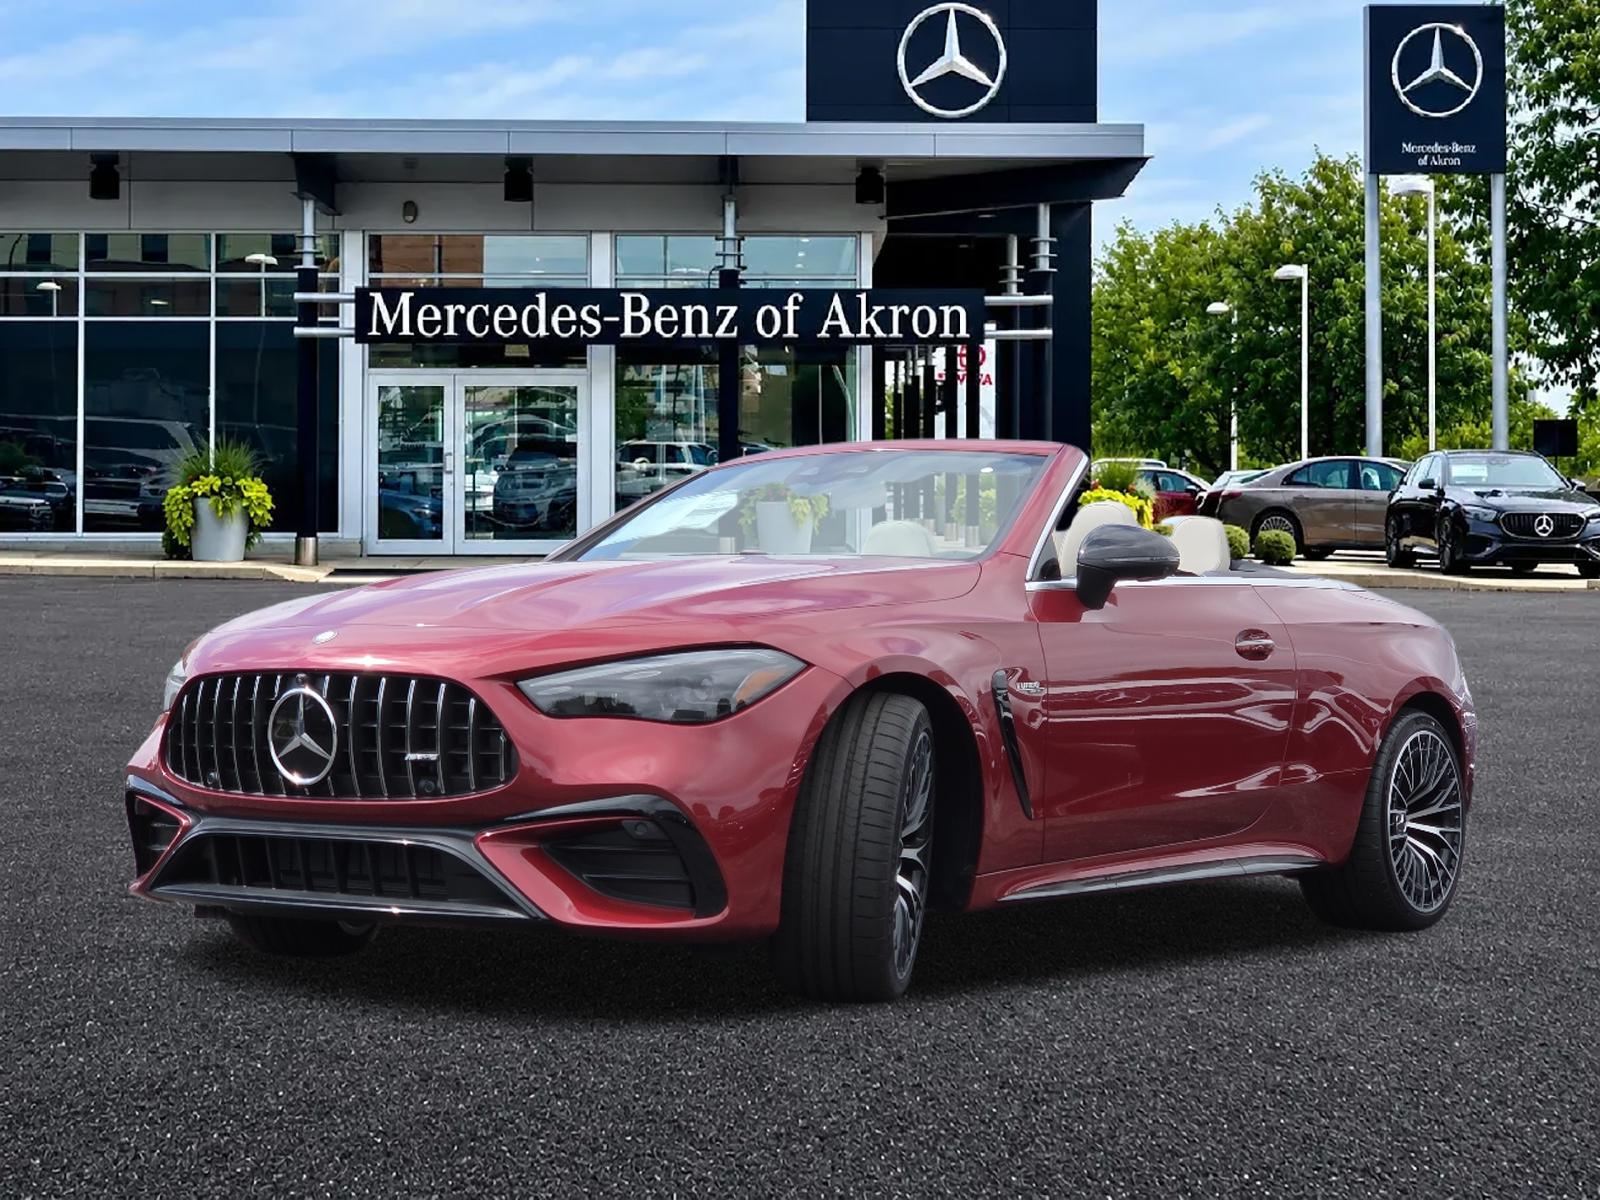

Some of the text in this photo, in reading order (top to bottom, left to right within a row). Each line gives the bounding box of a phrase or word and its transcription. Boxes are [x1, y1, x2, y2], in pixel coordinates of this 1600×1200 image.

[1417, 154, 1461, 166] of Akron
[367, 291, 970, 338] Mercedes-Benz of Akron
